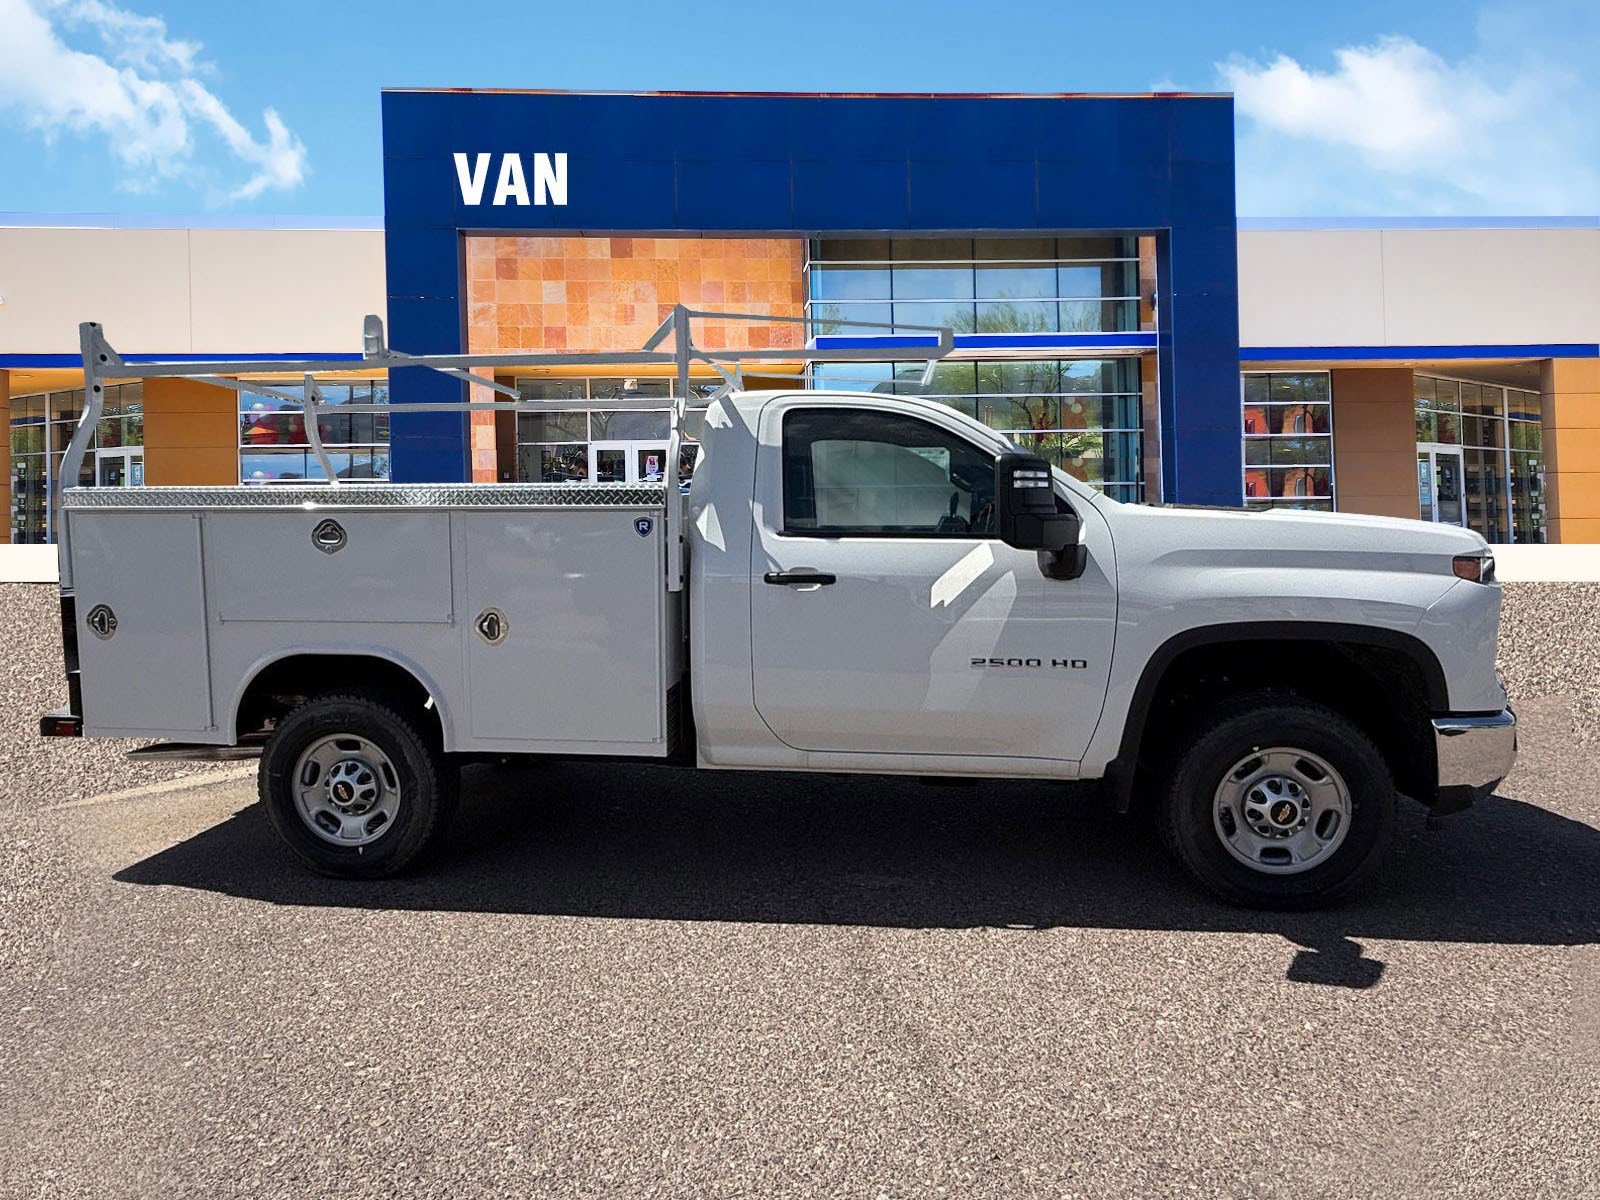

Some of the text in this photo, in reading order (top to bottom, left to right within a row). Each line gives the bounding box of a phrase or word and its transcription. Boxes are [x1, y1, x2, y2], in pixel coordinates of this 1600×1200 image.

[453, 152, 568, 206] VAN
[970, 658, 1088, 669] 2500 HD
